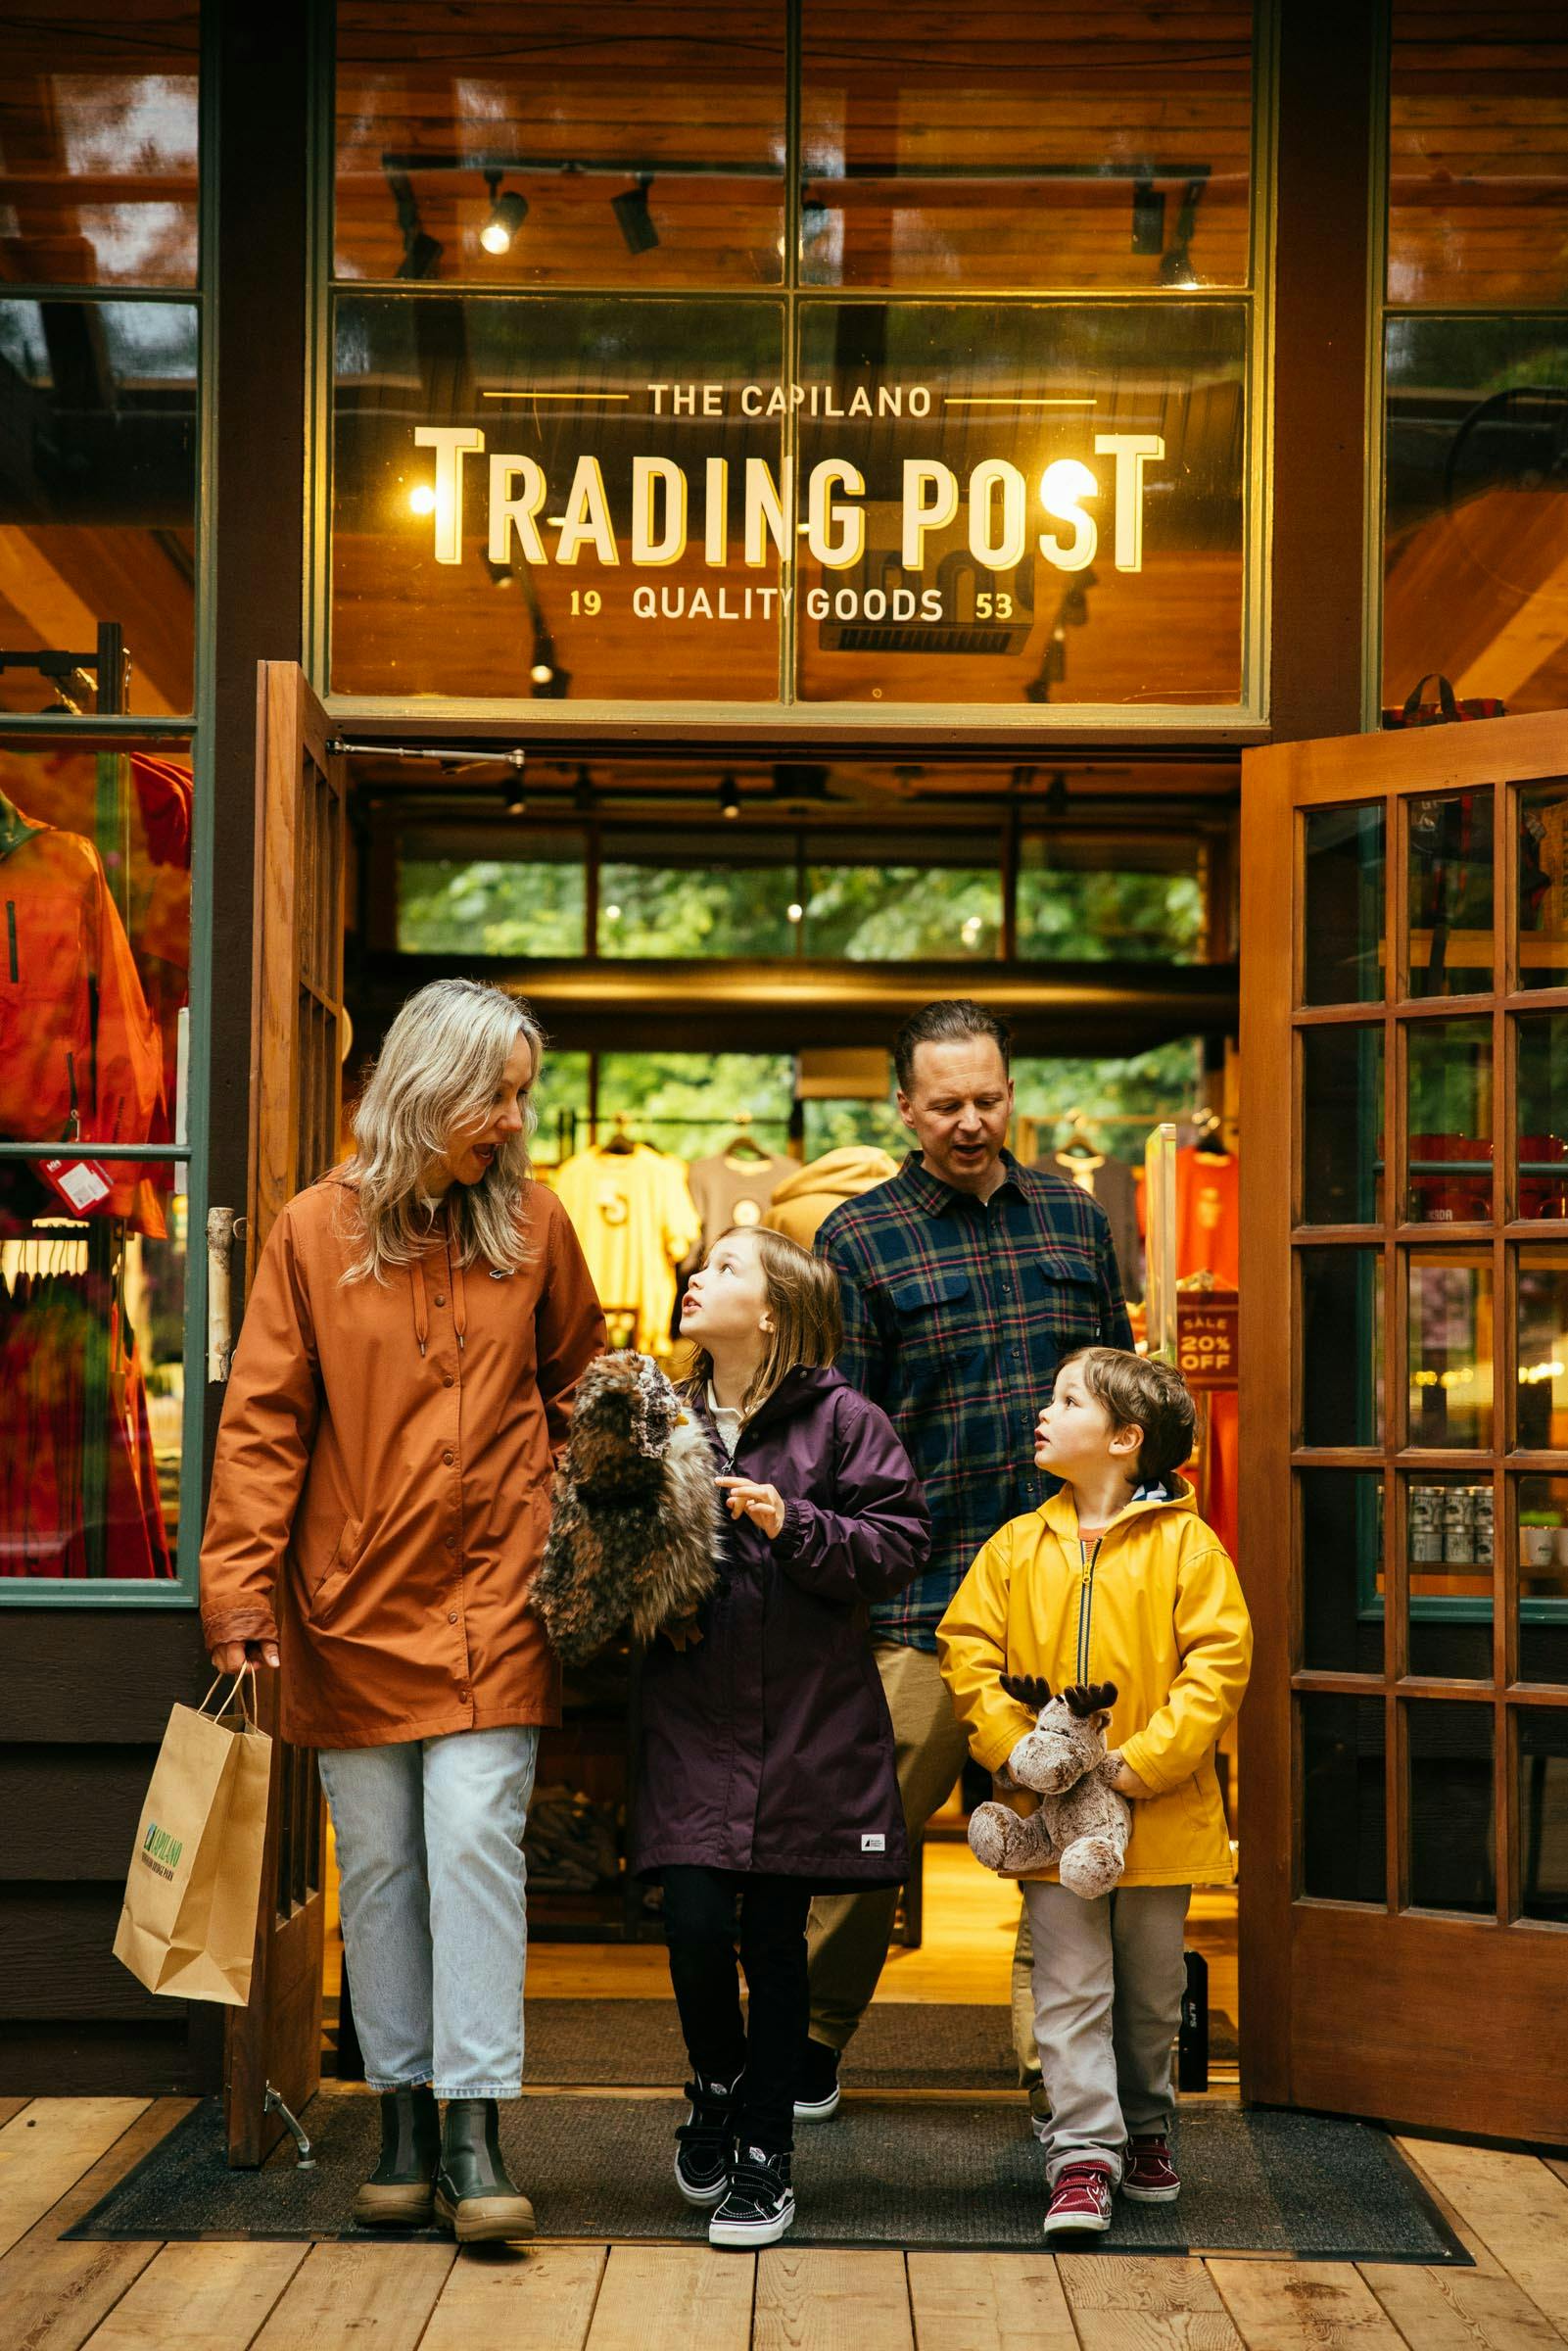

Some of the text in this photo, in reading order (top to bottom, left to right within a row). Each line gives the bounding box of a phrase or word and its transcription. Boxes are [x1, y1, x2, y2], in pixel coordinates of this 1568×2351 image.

[647, 384, 930, 416] THE CAPILANO
[414, 427, 1165, 572] TRADING POST
[569, 588, 1013, 621] 19 QUALITY GOODS 53
[1183, 1317, 1227, 1330] SALE
[1180, 1336, 1231, 1352] 20%
[1181, 1354, 1231, 1370] OFF
